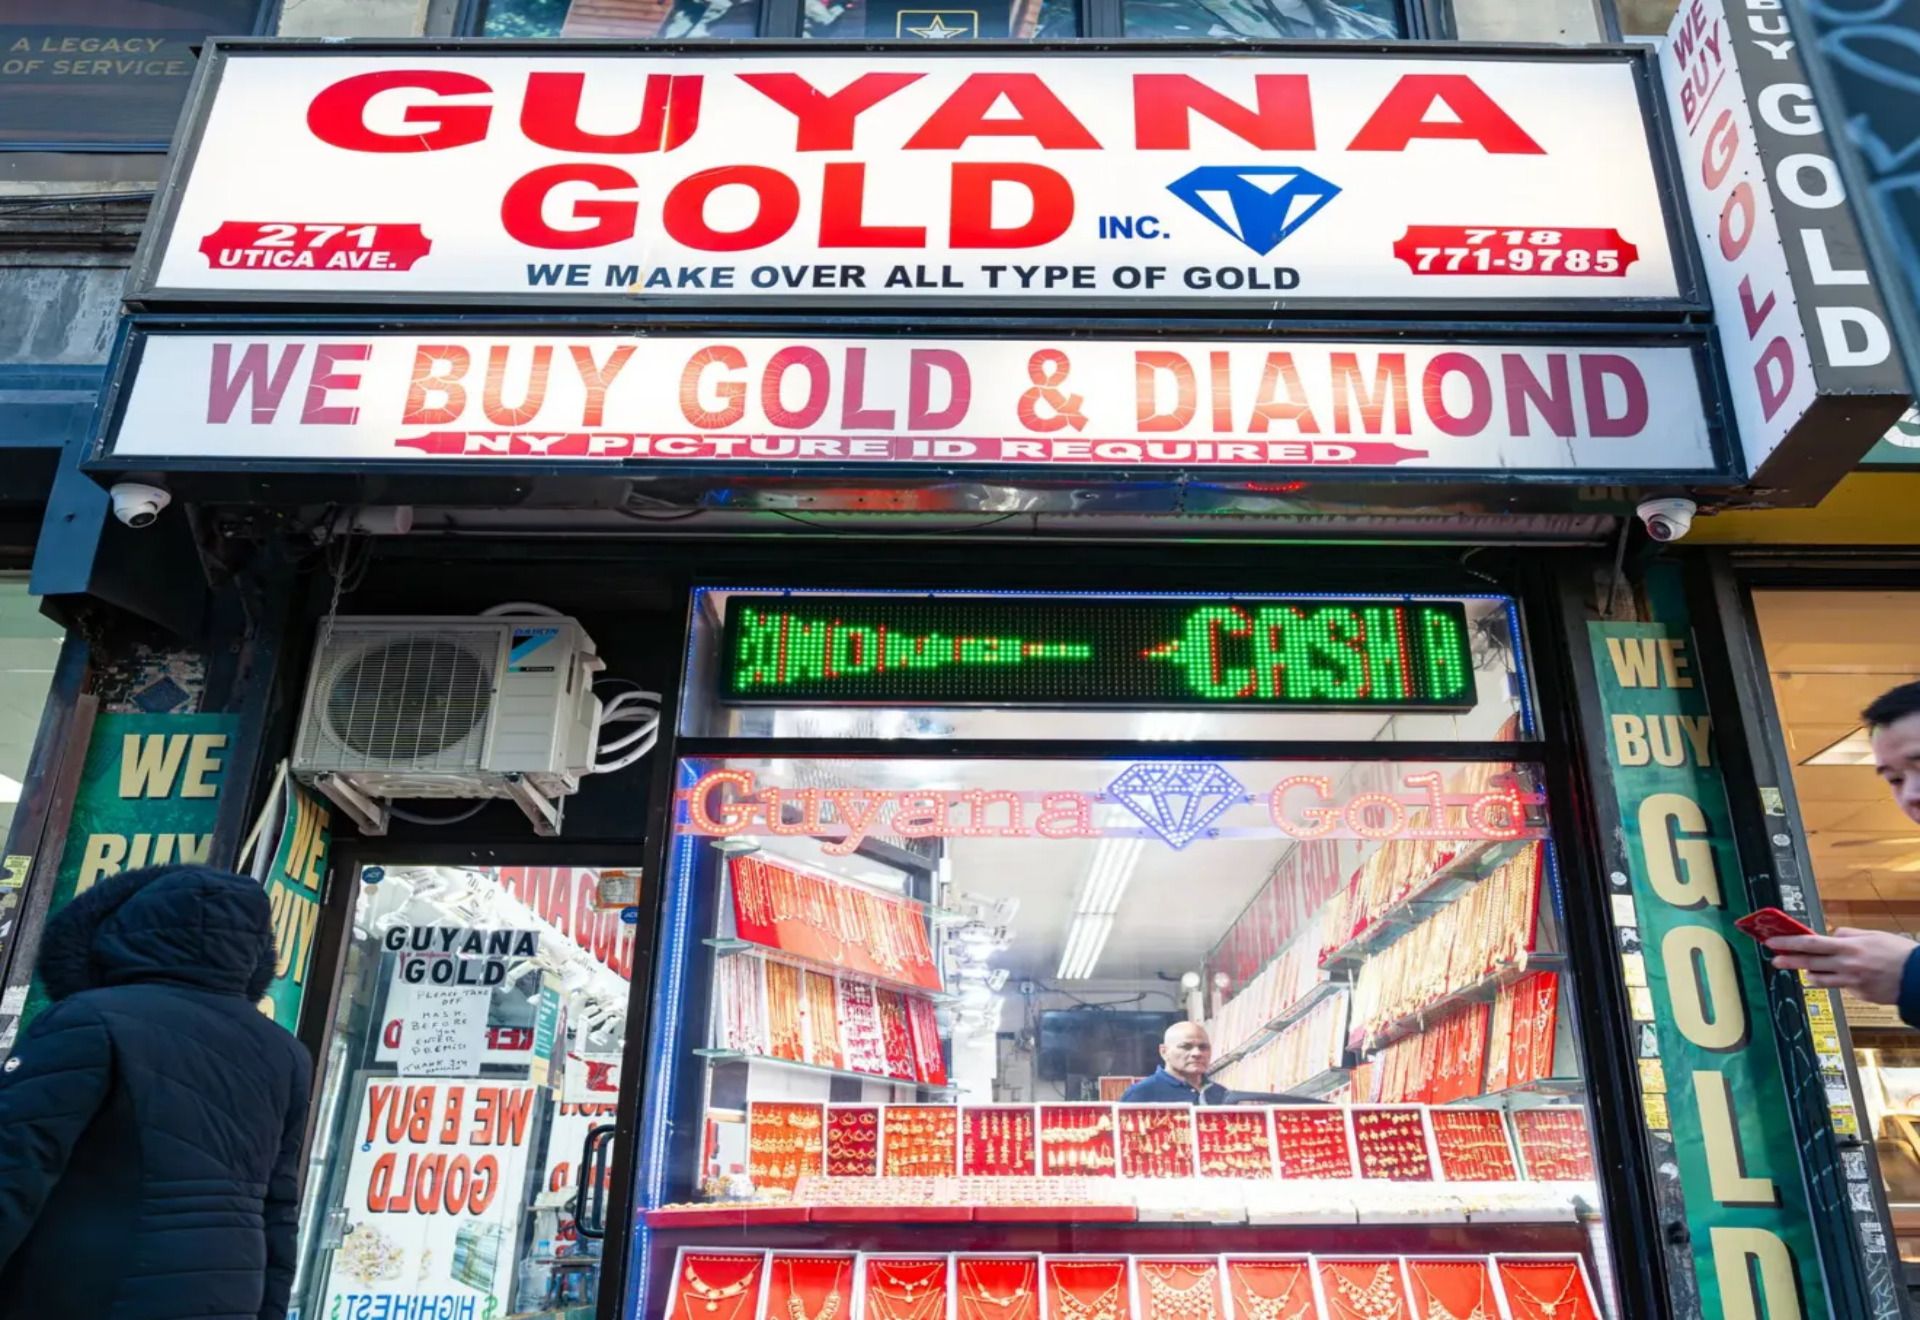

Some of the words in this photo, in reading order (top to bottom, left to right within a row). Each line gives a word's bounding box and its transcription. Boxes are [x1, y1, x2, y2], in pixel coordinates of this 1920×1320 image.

[10, 37, 31, 53] A
[41, 37, 166, 53] LEGACY
[1672, 0, 1707, 72] WE
[2, 59, 45, 75] OF
[1680, 18, 1722, 126] BUY
[306, 69, 1549, 155] GUYANA
[252, 223, 378, 249] 271
[500, 161, 1075, 252] GOLD
[1098, 215, 1170, 240] INC.
[1757, 83, 1891, 368] GOLD
[218, 248, 315, 268] UTICA
[325, 250, 397, 269] AVE.
[1415, 247, 1619, 273] 771-9785
[1464, 229, 1562, 245] 718
[1701, 108, 1795, 424] GOLD
[526, 263, 591, 287] WE
[605, 264, 735, 289] MAKE
[750, 265, 867, 289] OVER
[883, 265, 964, 289] ALL
[981, 265, 1096, 289] TYPE
[1112, 265, 1166, 290] OF
[1183, 266, 1300, 291] GOLD
[206, 343, 372, 425] WE
[401, 344, 639, 428] BUY
[679, 344, 971, 431] GOLD
[1016, 348, 1090, 433] &
[1134, 350, 1649, 439] DIAMOND
[463, 432, 568, 455] NY
[588, 433, 890, 458] PICTURE
[911, 439, 978, 458] ID
[1001, 440, 1357, 464] REQUIRED
[1184, 604, 1413, 699] CASH
[1606, 637, 1694, 689] WE
[118, 733, 227, 799] WE
[1611, 713, 1712, 767] BUY
[688, 769, 1103, 856] Guyana
[1268, 770, 1526, 841] Gold
[283, 798, 331, 891] WE
[385, 926, 537, 957] GUYANA
[405, 958, 506, 985] GOLD
[1637, 792, 1801, 1320] GOLD
